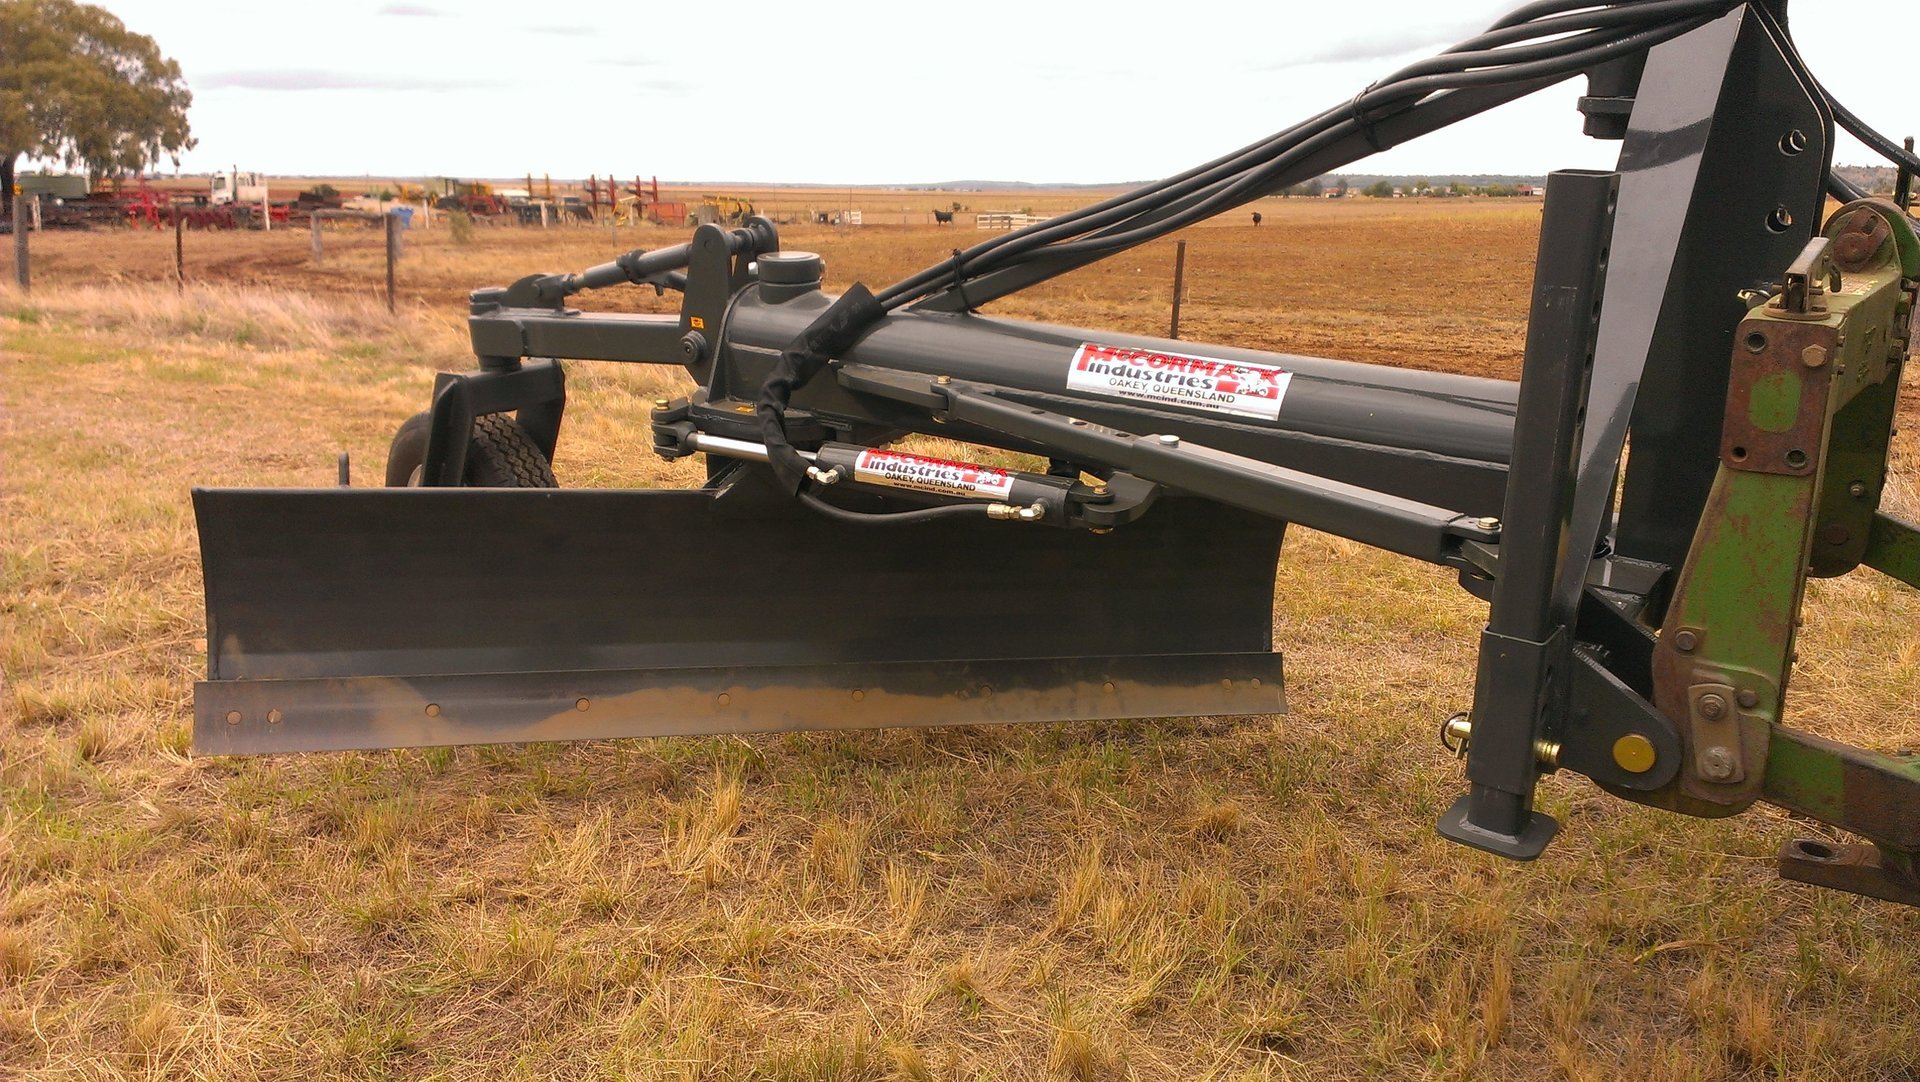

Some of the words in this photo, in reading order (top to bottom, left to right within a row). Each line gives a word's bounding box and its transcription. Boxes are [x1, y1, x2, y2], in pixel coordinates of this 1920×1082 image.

[1076, 343, 1288, 386] McCORMAK
[1088, 362, 1213, 390] industries
[1109, 377, 1148, 393] OAKEY,
[1153, 384, 1236, 404] QUEENSLAND
[1118, 389, 1220, 410] www.mcind.com.au
[861, 448, 1008, 477] McCORMAK
[869, 460, 960, 482] industries
[884, 472, 915, 484] OAKEY,
[916, 477, 976, 492] QUEENSLAND
[893, 482, 966, 496] www.mcind.com.au
